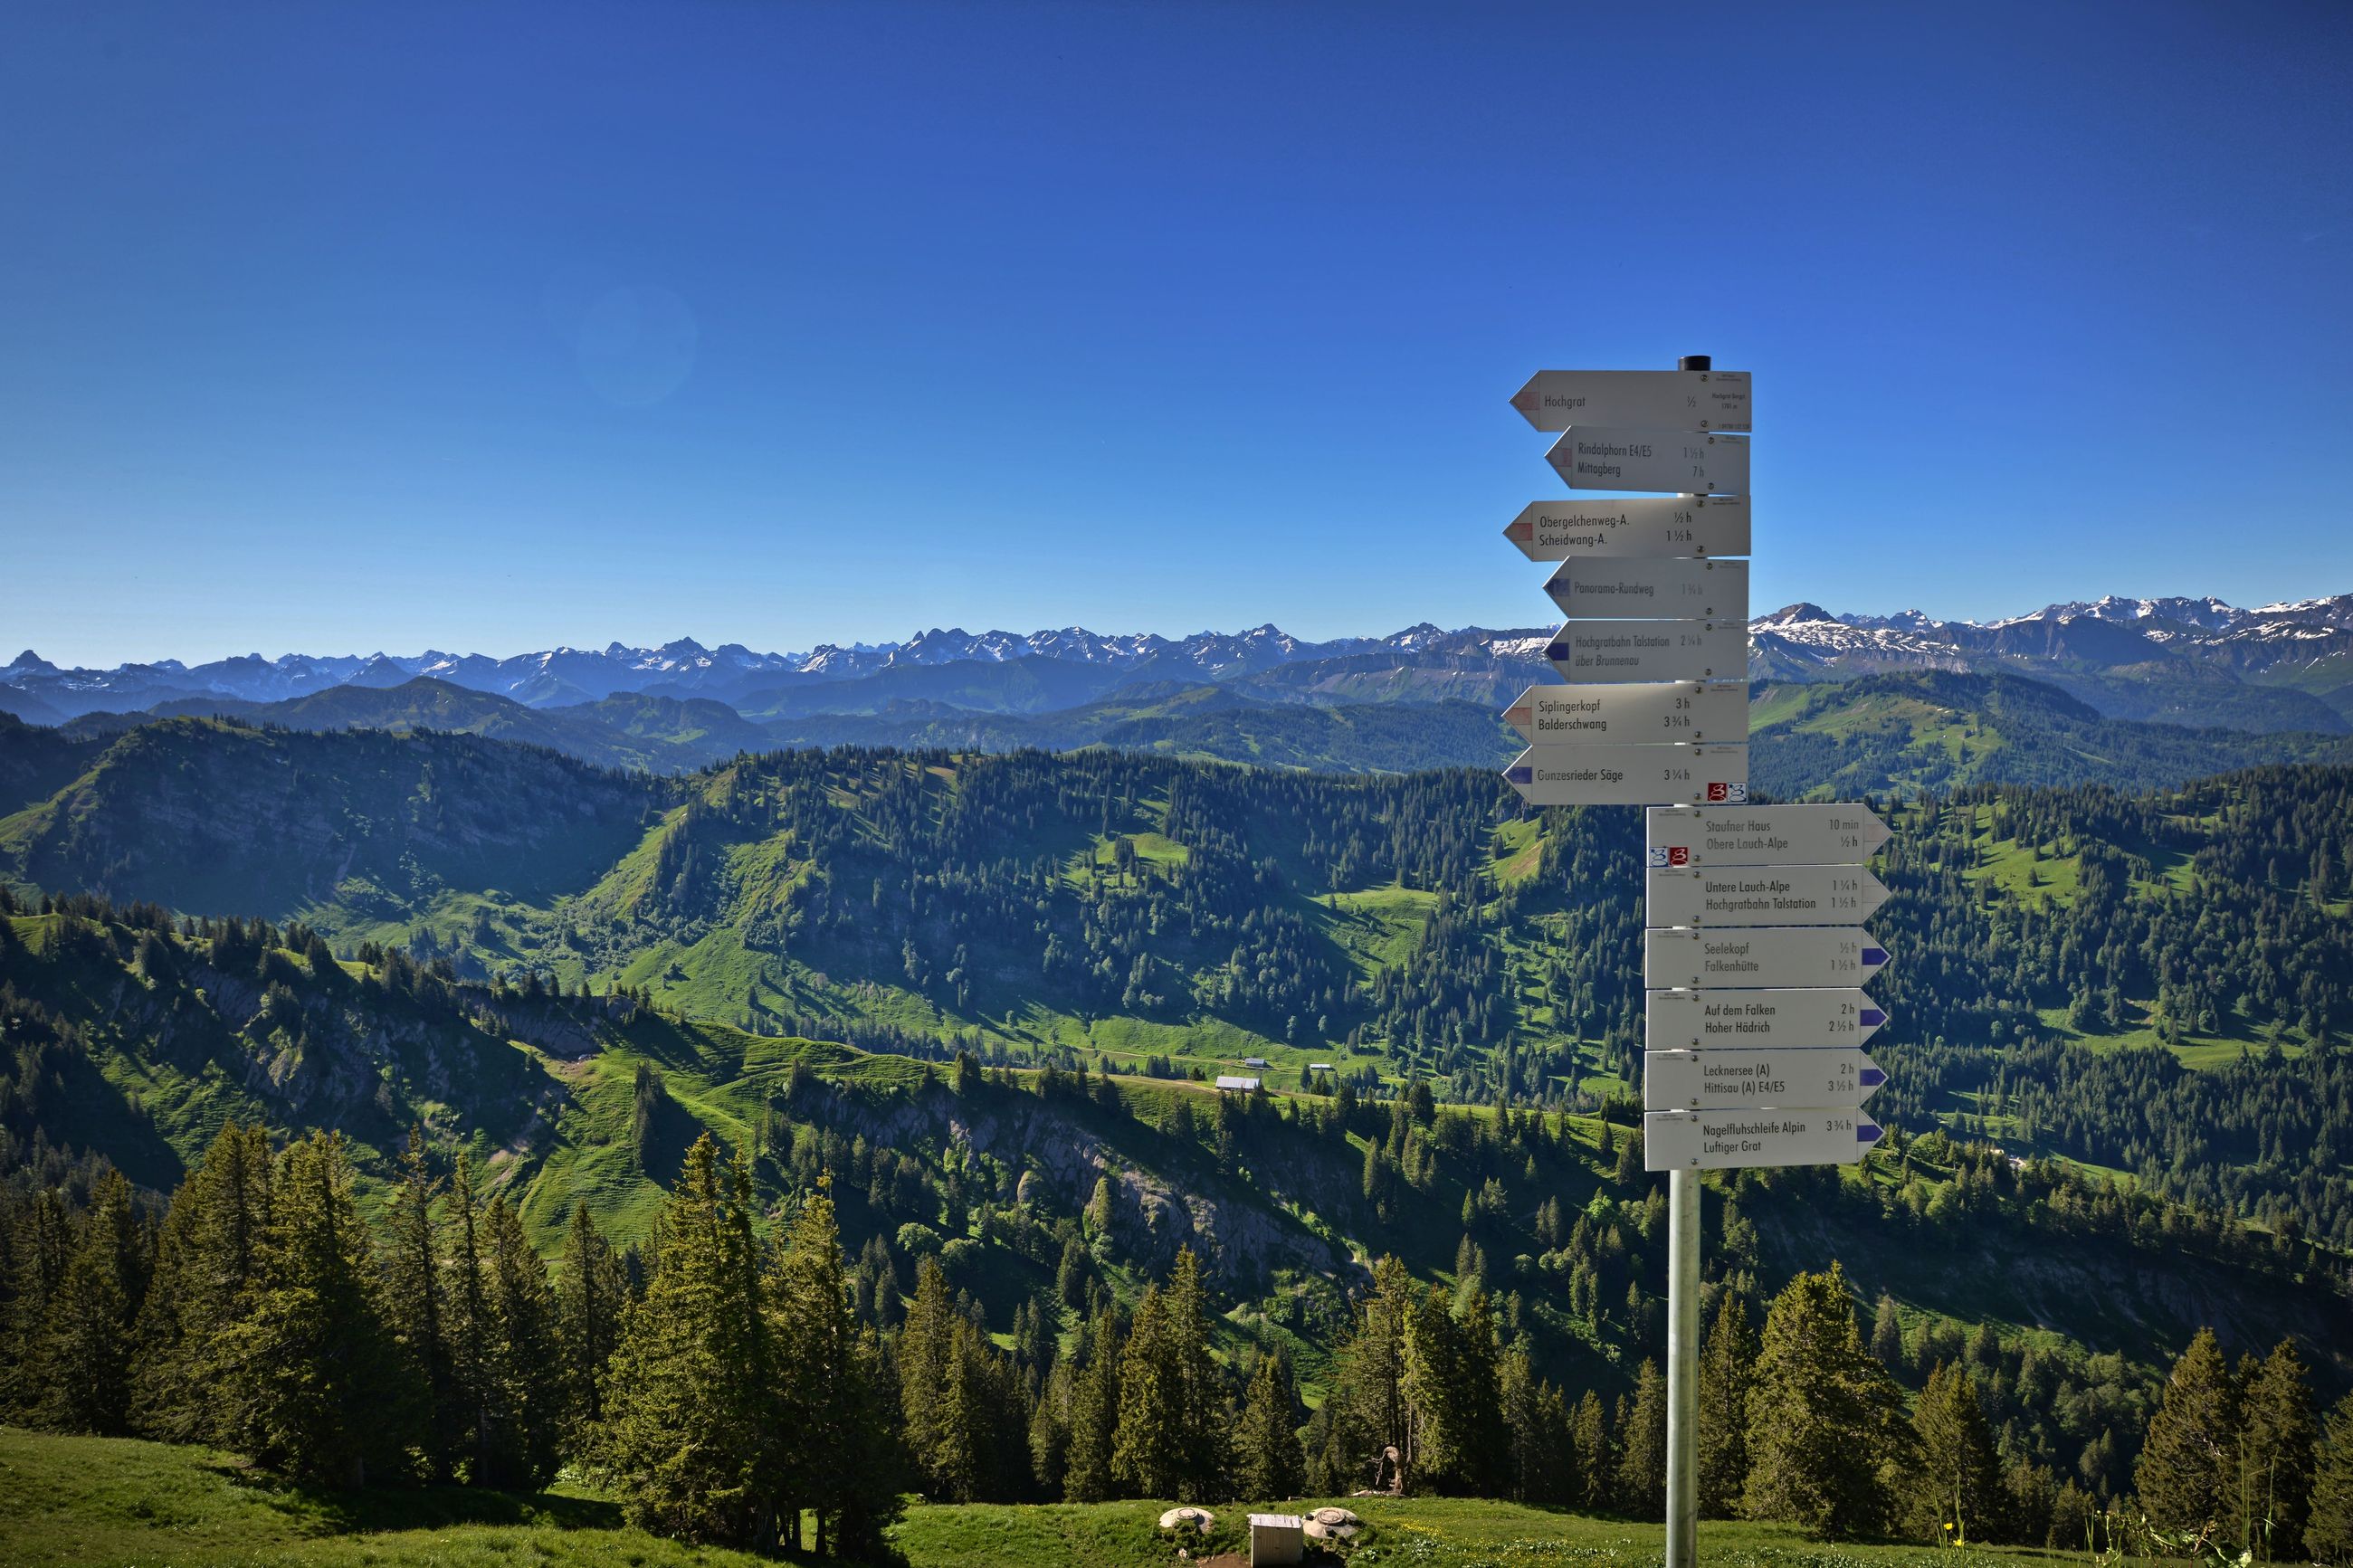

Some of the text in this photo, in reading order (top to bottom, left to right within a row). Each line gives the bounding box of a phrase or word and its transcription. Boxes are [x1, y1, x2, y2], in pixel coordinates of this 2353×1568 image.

[1545, 395, 1586, 409] Hochgrat
[1578, 443, 1627, 458] Rindalphorn
[1629, 445, 1652, 458] E4/E5
[1683, 447, 1687, 457] 1
[1699, 448, 1704, 460] h
[1578, 462, 1704, 477] Mittagberg 7 h
[1540, 514, 1629, 529] Obergelchenweg-A.
[1686, 512, 1691, 523] h
[1539, 533, 1607, 547] Scheidwang-A.
[1667, 531, 1671, 542] 1
[1686, 531, 1692, 541] h
[1575, 582, 1654, 597] Panorama-Rundweg
[1576, 635, 1631, 650] Hochgratbahn
[1634, 635, 1670, 647] Talstation
[1681, 636, 1686, 646] 2
[1576, 655, 1639, 666] über Brunnenau
[1538, 698, 1690, 715] Siplingerkopf 3 h
[1538, 718, 1606, 732] Balderschwang
[1664, 717, 1670, 727] 3
[1684, 715, 1690, 727] h
[1538, 769, 1597, 782] Gunzesrieder
[1601, 768, 1623, 783] Säge
[1664, 770, 1670, 781] 3
[1684, 769, 1690, 780] h
[1706, 820, 1859, 832] Staufner Haus 10 min
[1707, 838, 1735, 850] Obere
[1737, 837, 1788, 851] Lauch-Alpe
[1853, 836, 1858, 847] h
[1706, 881, 1737, 893] Untere
[1739, 879, 1790, 894] Lauch-Alpe
[1833, 880, 1836, 890] 1
[1851, 879, 1857, 890] h
[1706, 898, 1769, 913] Hochgratbahn
[1772, 898, 1815, 909] Talstation
[1832, 898, 1835, 908] 1
[1851, 898, 1856, 908] h
[1704, 942, 1749, 956] Seelekopf
[1851, 942, 1857, 954] h
[1705, 960, 1758, 972] Falkenhütte
[1832, 960, 1834, 970] 1
[1850, 959, 1855, 971] h
[1705, 1003, 1854, 1016] Auf dem Falken 2 h
[1705, 1022, 1733, 1033] Hoher
[1736, 1022, 1769, 1032] Hädrich
[1829, 1021, 1834, 1031] 2
[1848, 1021, 1853, 1031] h
[1704, 1063, 1853, 1078] Lecknersee (A) 2 h
[1704, 1082, 1739, 1093] Hittisau
[1741, 1081, 1756, 1095] (A)
[1758, 1081, 1785, 1093] E4/E5
[1827, 1080, 1834, 1090] 3
[1847, 1079, 1853, 1090] h
[1703, 1123, 1779, 1137] Nagelfluhschleife
[1782, 1122, 1805, 1134] Alpin
[1826, 1121, 1833, 1131] 3
[1845, 1120, 1852, 1131] h
[1704, 1140, 1761, 1155] Luftiger Grat
